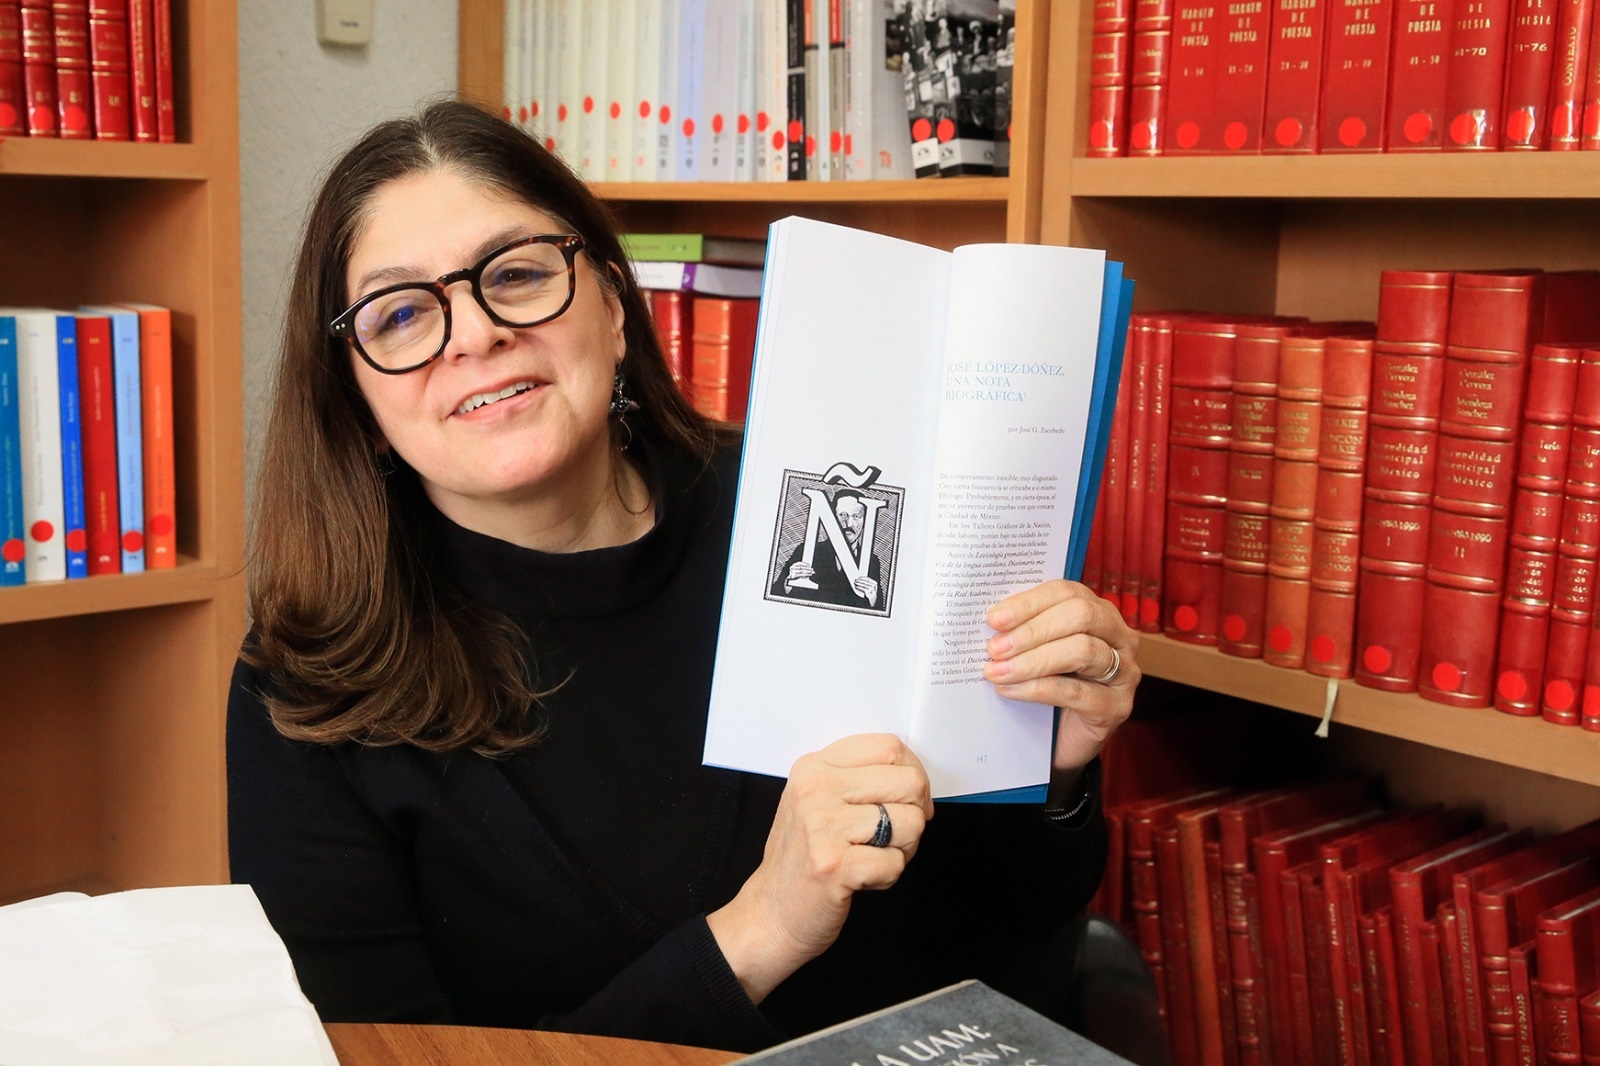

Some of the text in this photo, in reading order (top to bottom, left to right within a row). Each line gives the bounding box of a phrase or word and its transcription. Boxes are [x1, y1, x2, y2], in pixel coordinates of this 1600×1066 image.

[946, 360, 972, 376] JOSÉ
[946, 376, 1011, 388] UNA NOTA
[949, 473, 995, 481] tmperamento
[966, 493, 1010, 502] Probablemente,
[996, 504, 1016, 512] pruebas
[973, 522, 995, 530] Talleres
[942, 668, 962, 676] Talleres
[900, 1024, 991, 1061] UAM:
